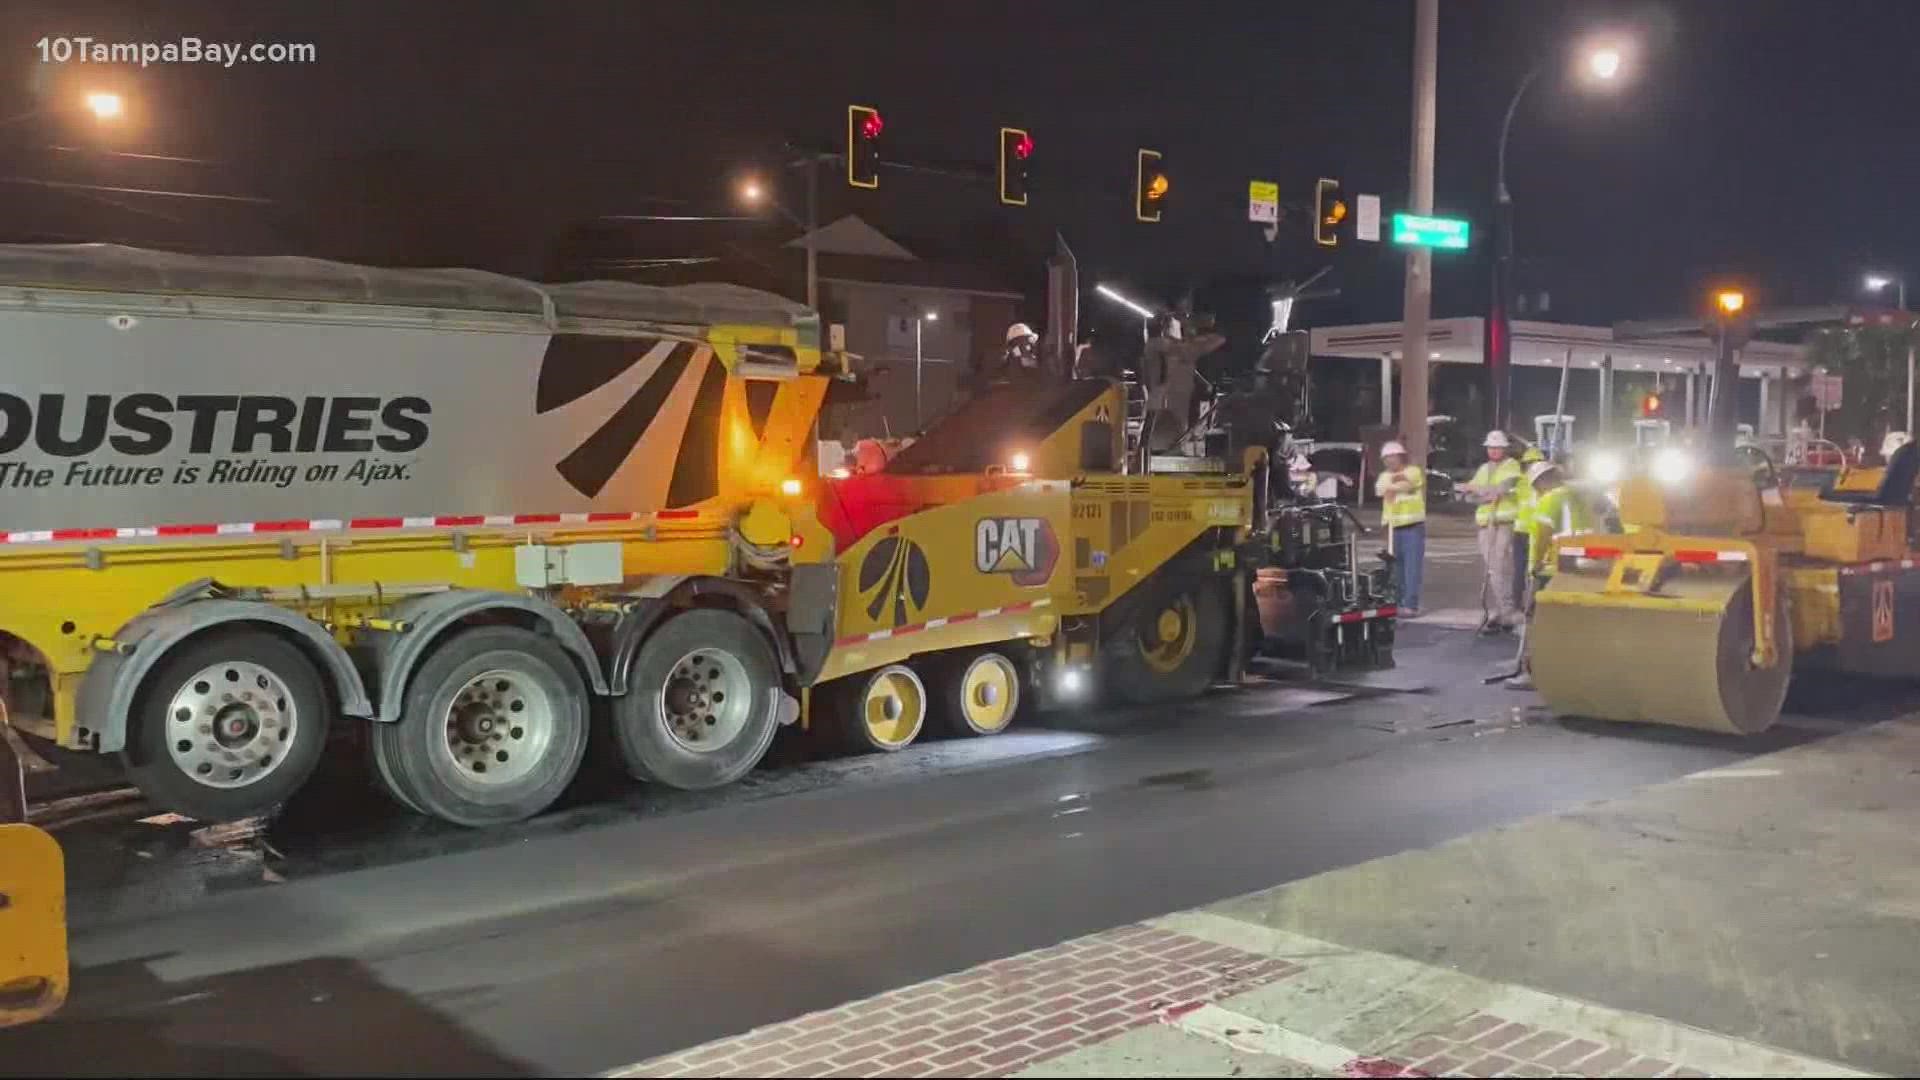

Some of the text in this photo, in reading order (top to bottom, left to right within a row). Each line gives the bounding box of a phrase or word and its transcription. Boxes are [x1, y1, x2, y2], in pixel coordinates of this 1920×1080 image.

[0, 457, 412, 489] The Future is Riding on Ajax.
[976, 518, 1041, 572] CAT
